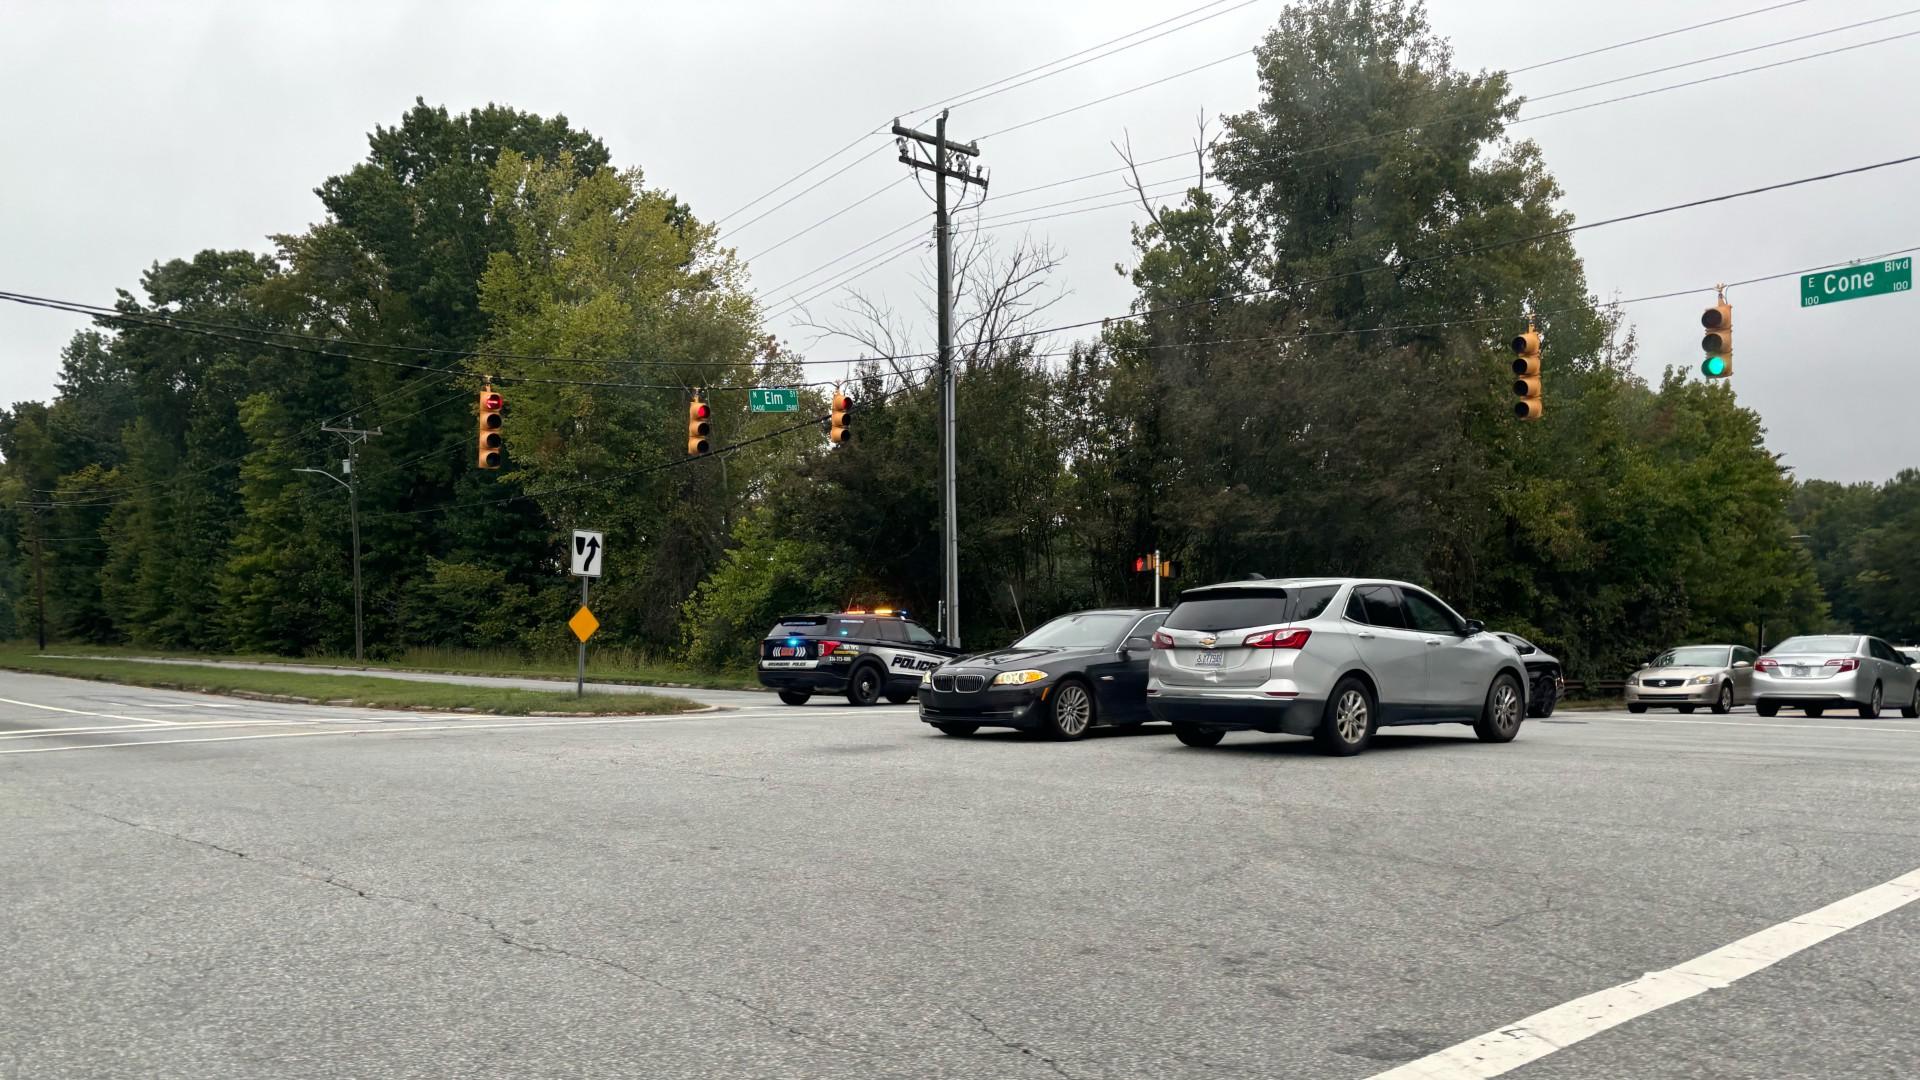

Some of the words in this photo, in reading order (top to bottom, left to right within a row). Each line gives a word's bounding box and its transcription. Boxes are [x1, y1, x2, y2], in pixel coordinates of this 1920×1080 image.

[1808, 277, 1815, 288] E
[1824, 271, 1875, 294] Cone
[1884, 259, 1909, 273] Blvd
[1893, 280, 1909, 292] 100
[1804, 295, 1820, 306] 100
[764, 391, 784, 405] Elm
